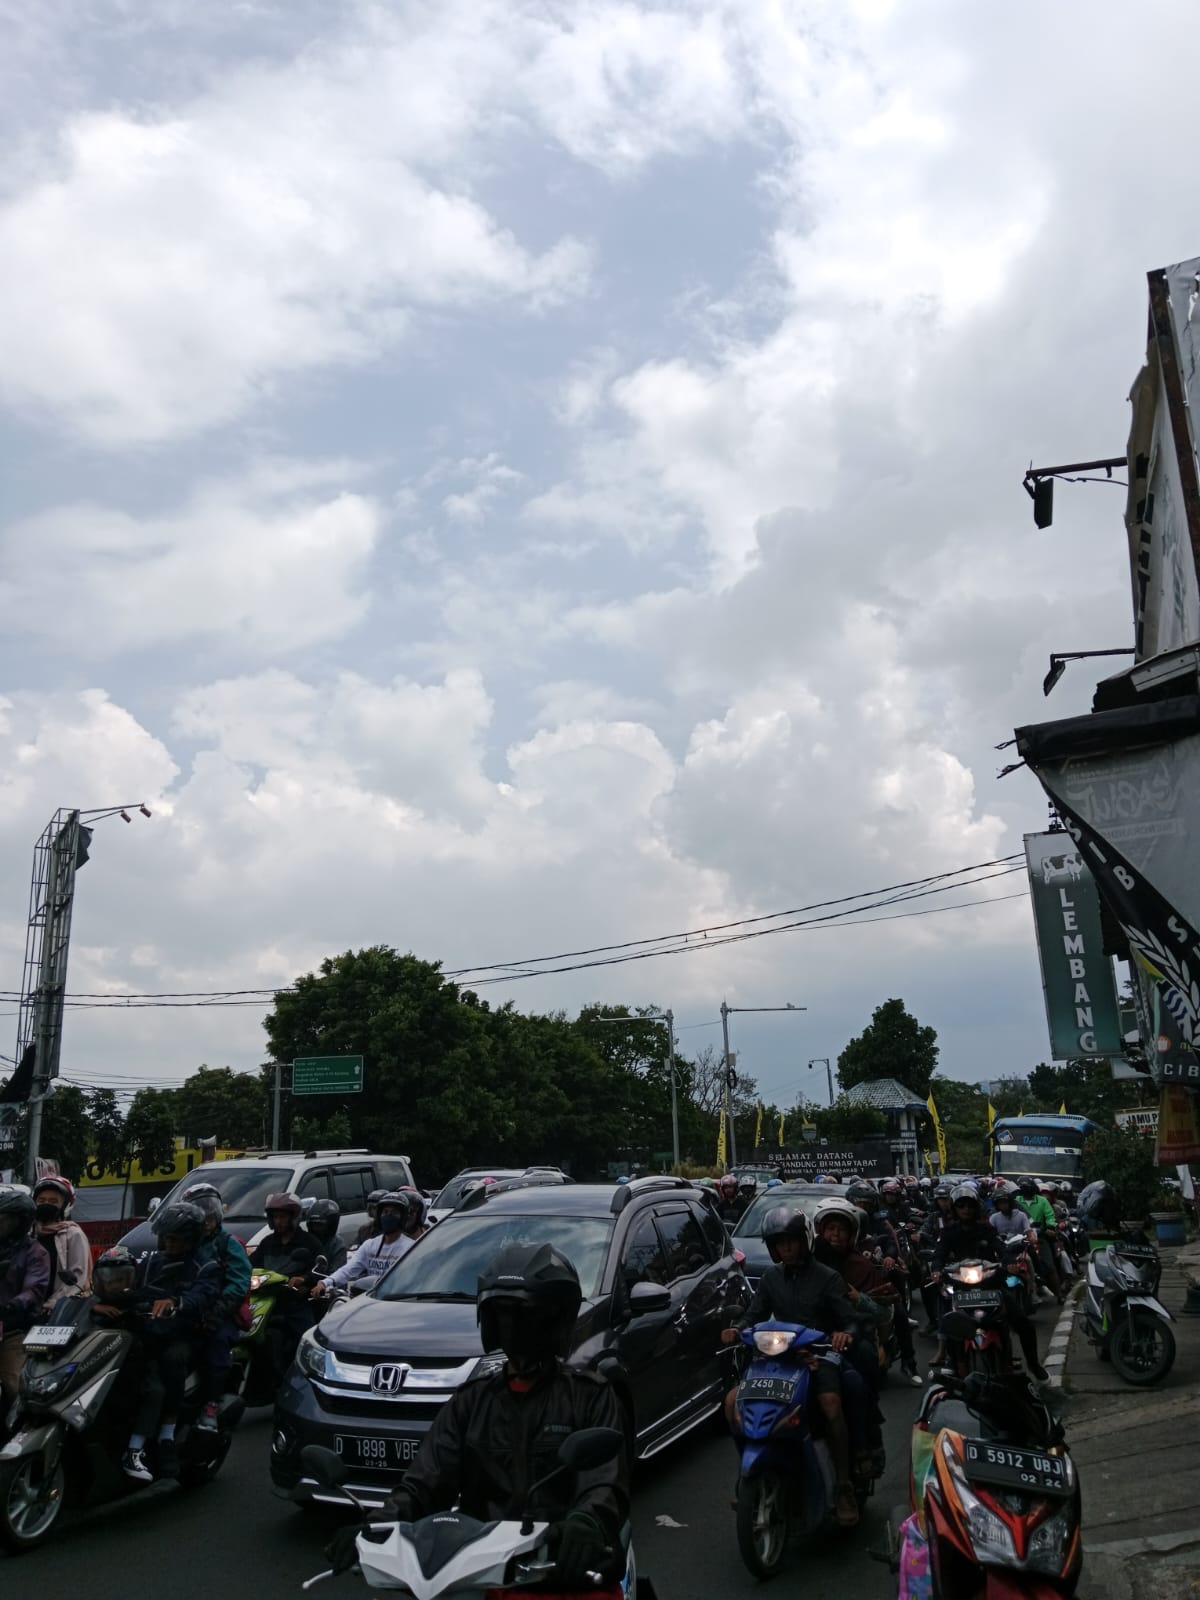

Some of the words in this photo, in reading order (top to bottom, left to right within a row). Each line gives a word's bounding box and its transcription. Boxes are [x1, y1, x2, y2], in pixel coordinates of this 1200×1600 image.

[1059, 888, 1098, 1053] LEMBANG
[1126, 1114, 1150, 1124] JAMU
[817, 1152, 854, 1160] DATANG
[819, 1159, 877, 1168] BERMARTABAT
[751, 1379, 774, 1388] 2450
[336, 1437, 343, 1455] D
[356, 1439, 386, 1458] 1898
[969, 1446, 978, 1459] D
[987, 1449, 1024, 1468] 5912
[1033, 1457, 1060, 1475] UBJ
[1020, 1473, 1037, 1483] 02
